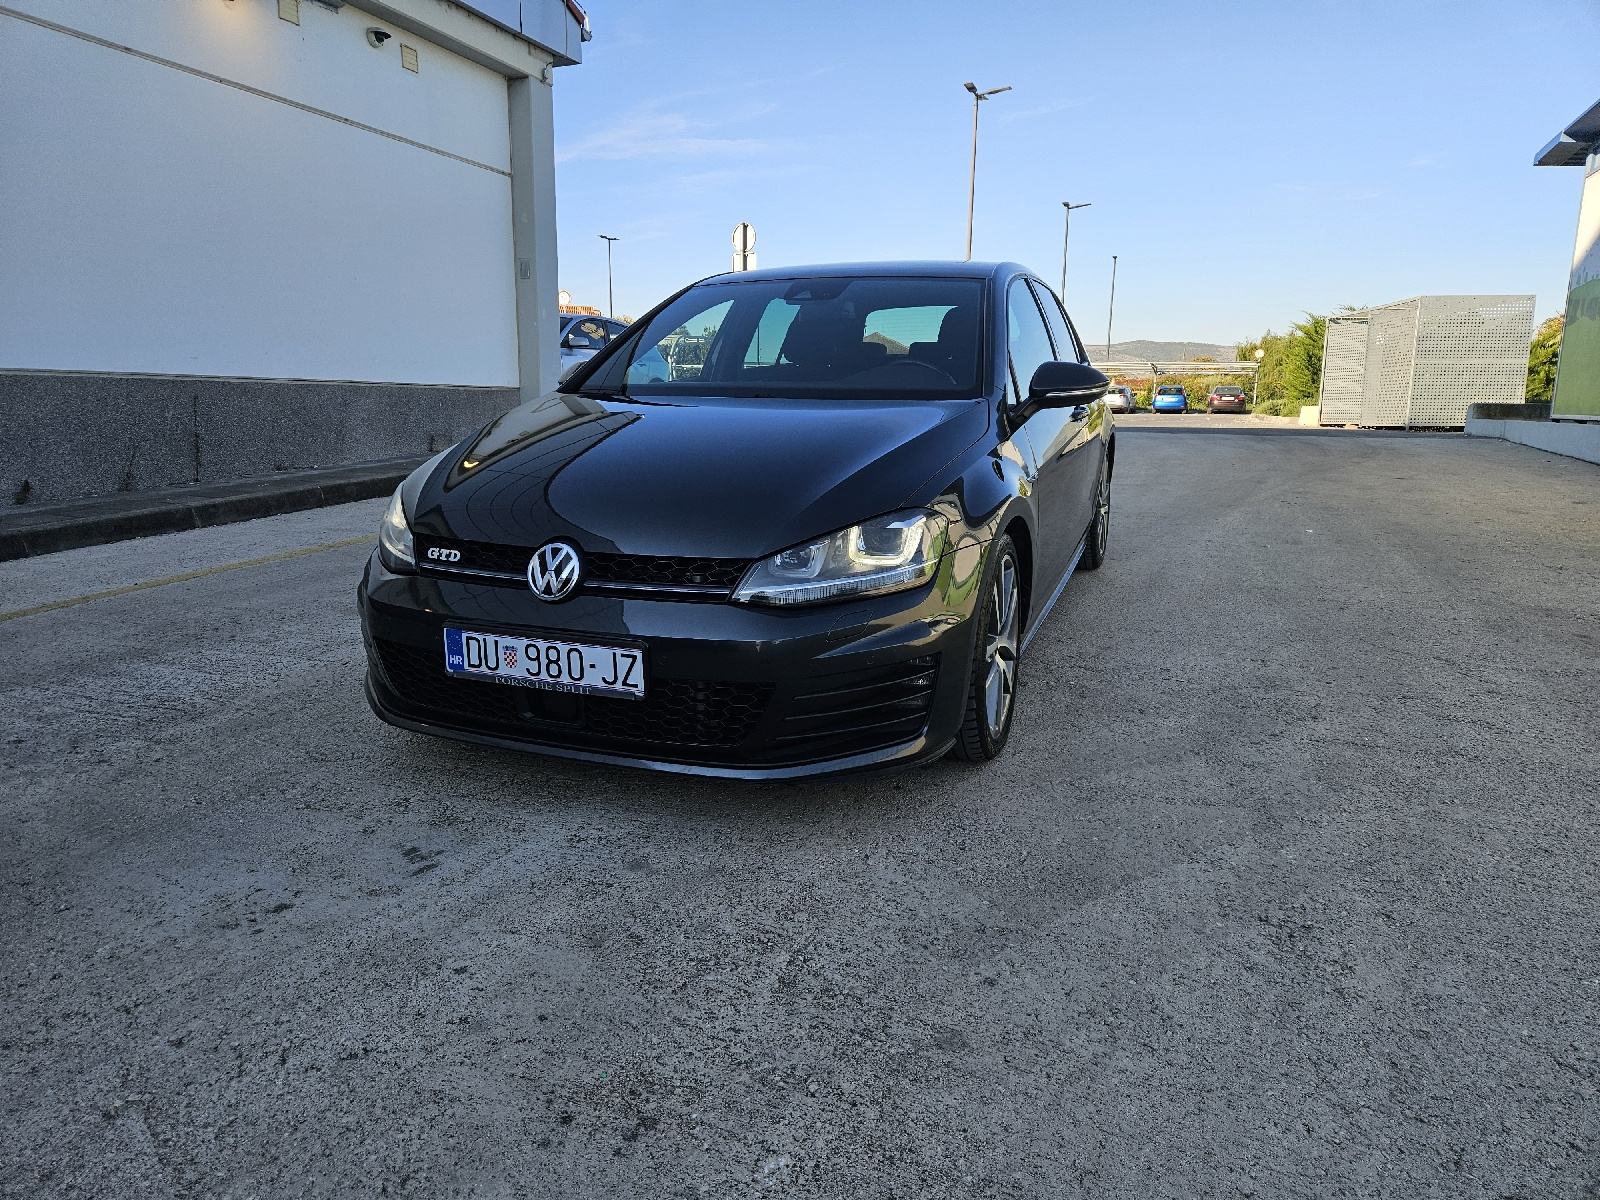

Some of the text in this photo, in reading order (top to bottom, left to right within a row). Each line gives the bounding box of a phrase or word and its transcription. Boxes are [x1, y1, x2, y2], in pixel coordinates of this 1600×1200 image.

[427, 547, 461, 562] GTD
[449, 654, 463, 665] HR
[465, 635, 639, 689] DU 980-JZ
[495, 676, 592, 695] PORSCHE SPLIT
